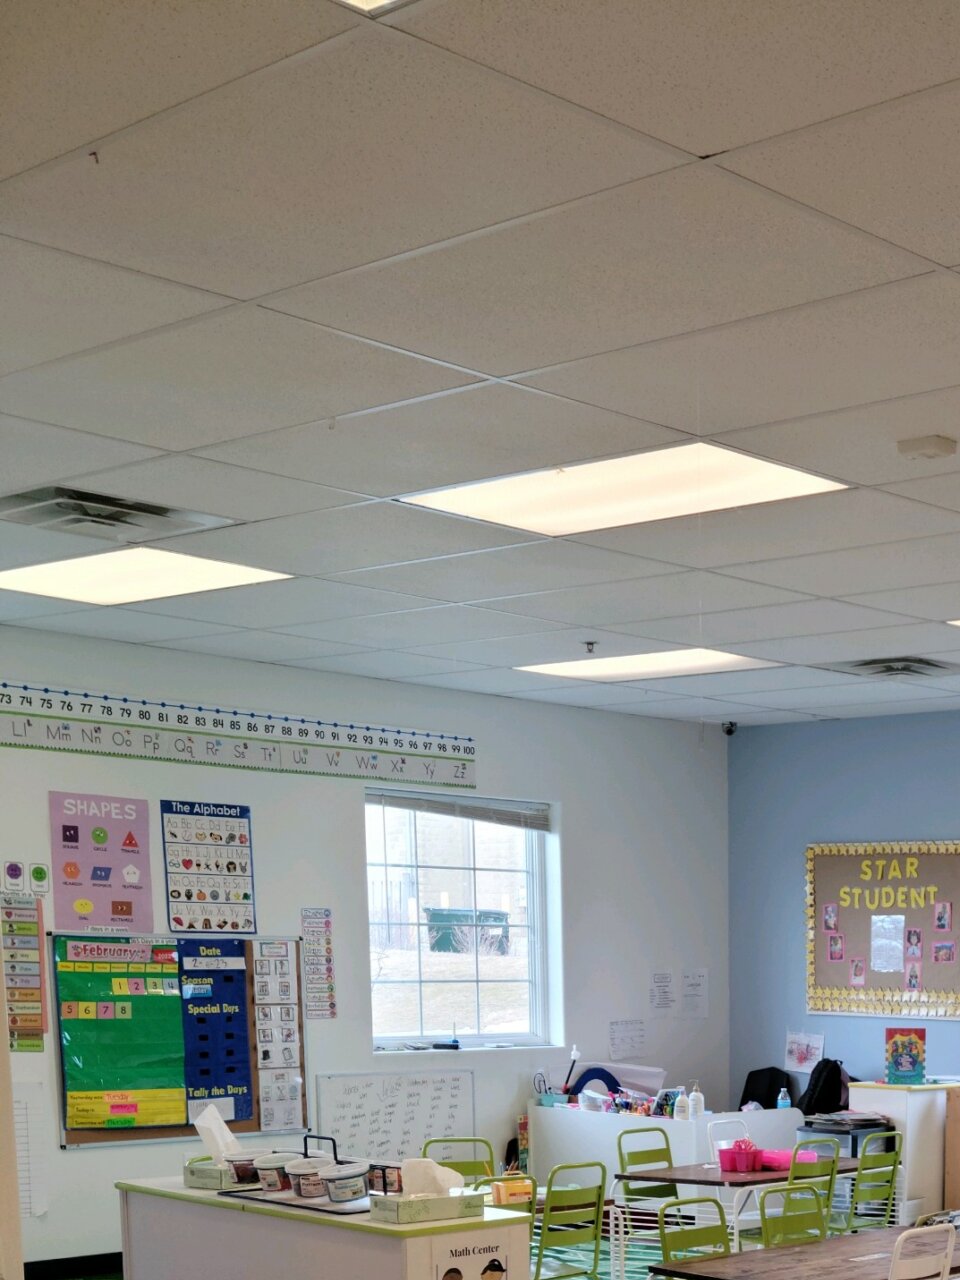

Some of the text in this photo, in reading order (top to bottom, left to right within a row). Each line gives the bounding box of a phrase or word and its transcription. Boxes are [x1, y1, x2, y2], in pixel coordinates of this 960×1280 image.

[0, 694, 475, 755] 73 74 75 76 77 78 79 80 81 82 83 84 85 86 87 88 89 90 91 92 93 94 95 96 97 98 99 100
[63, 798, 137, 820] SHAPES
[171, 801, 240, 817] The Alphabet
[860, 857, 919, 880] STAR
[839, 886, 938, 910] STUDENT
[82, 945, 137, 960] February
[199, 946, 222, 956] Date
[118, 982, 174, 990] 1 2 3 4
[181, 975, 214, 985] Season
[67, 1005, 127, 1014] 5 6 7 8
[187, 1003, 240, 1015] Special Days
[188, 1084, 247, 1099] Tally the Days
[449, 1244, 500, 1258] Math Center
